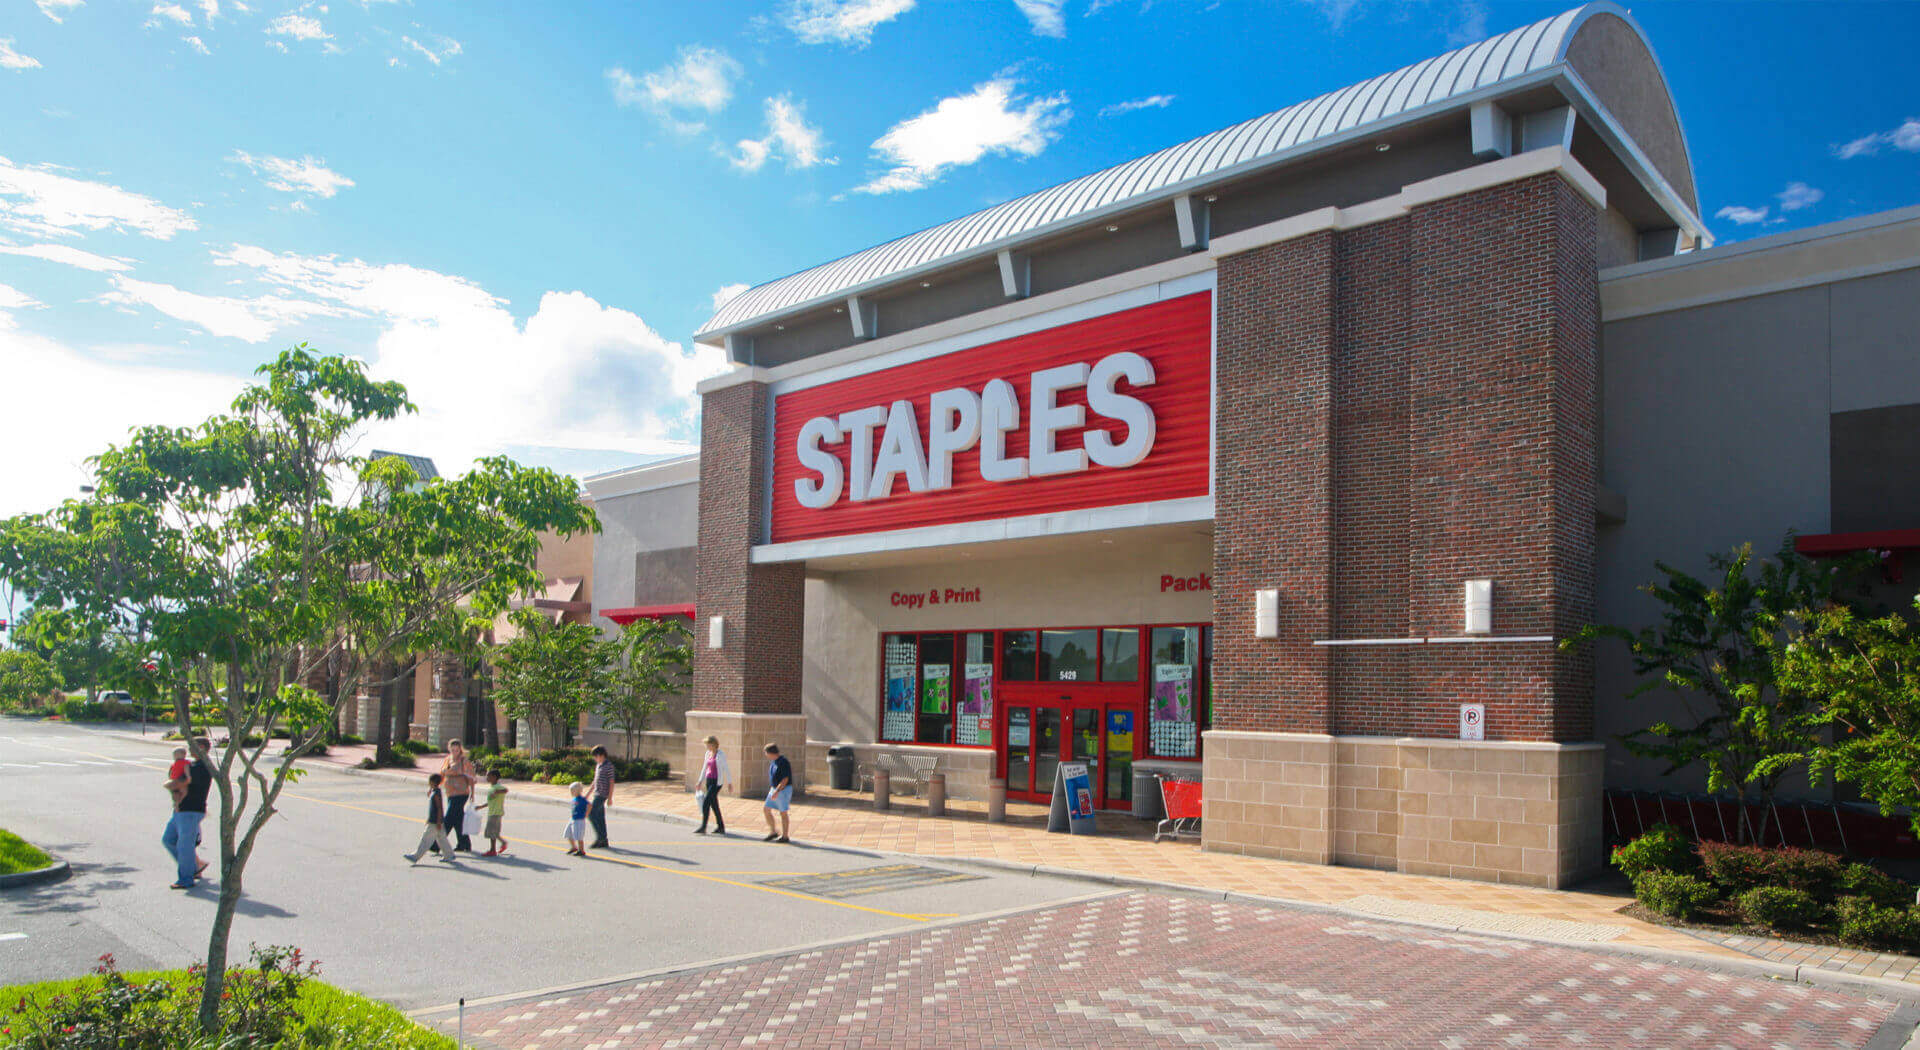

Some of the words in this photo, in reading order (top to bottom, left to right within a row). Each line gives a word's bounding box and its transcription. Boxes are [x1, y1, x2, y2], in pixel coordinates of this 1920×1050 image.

[795, 351, 1156, 508] STAPLES
[1161, 572, 1212, 592] Pack
[891, 592, 925, 609] Copy
[929, 589, 939, 604] &
[944, 587, 981, 603] Print
